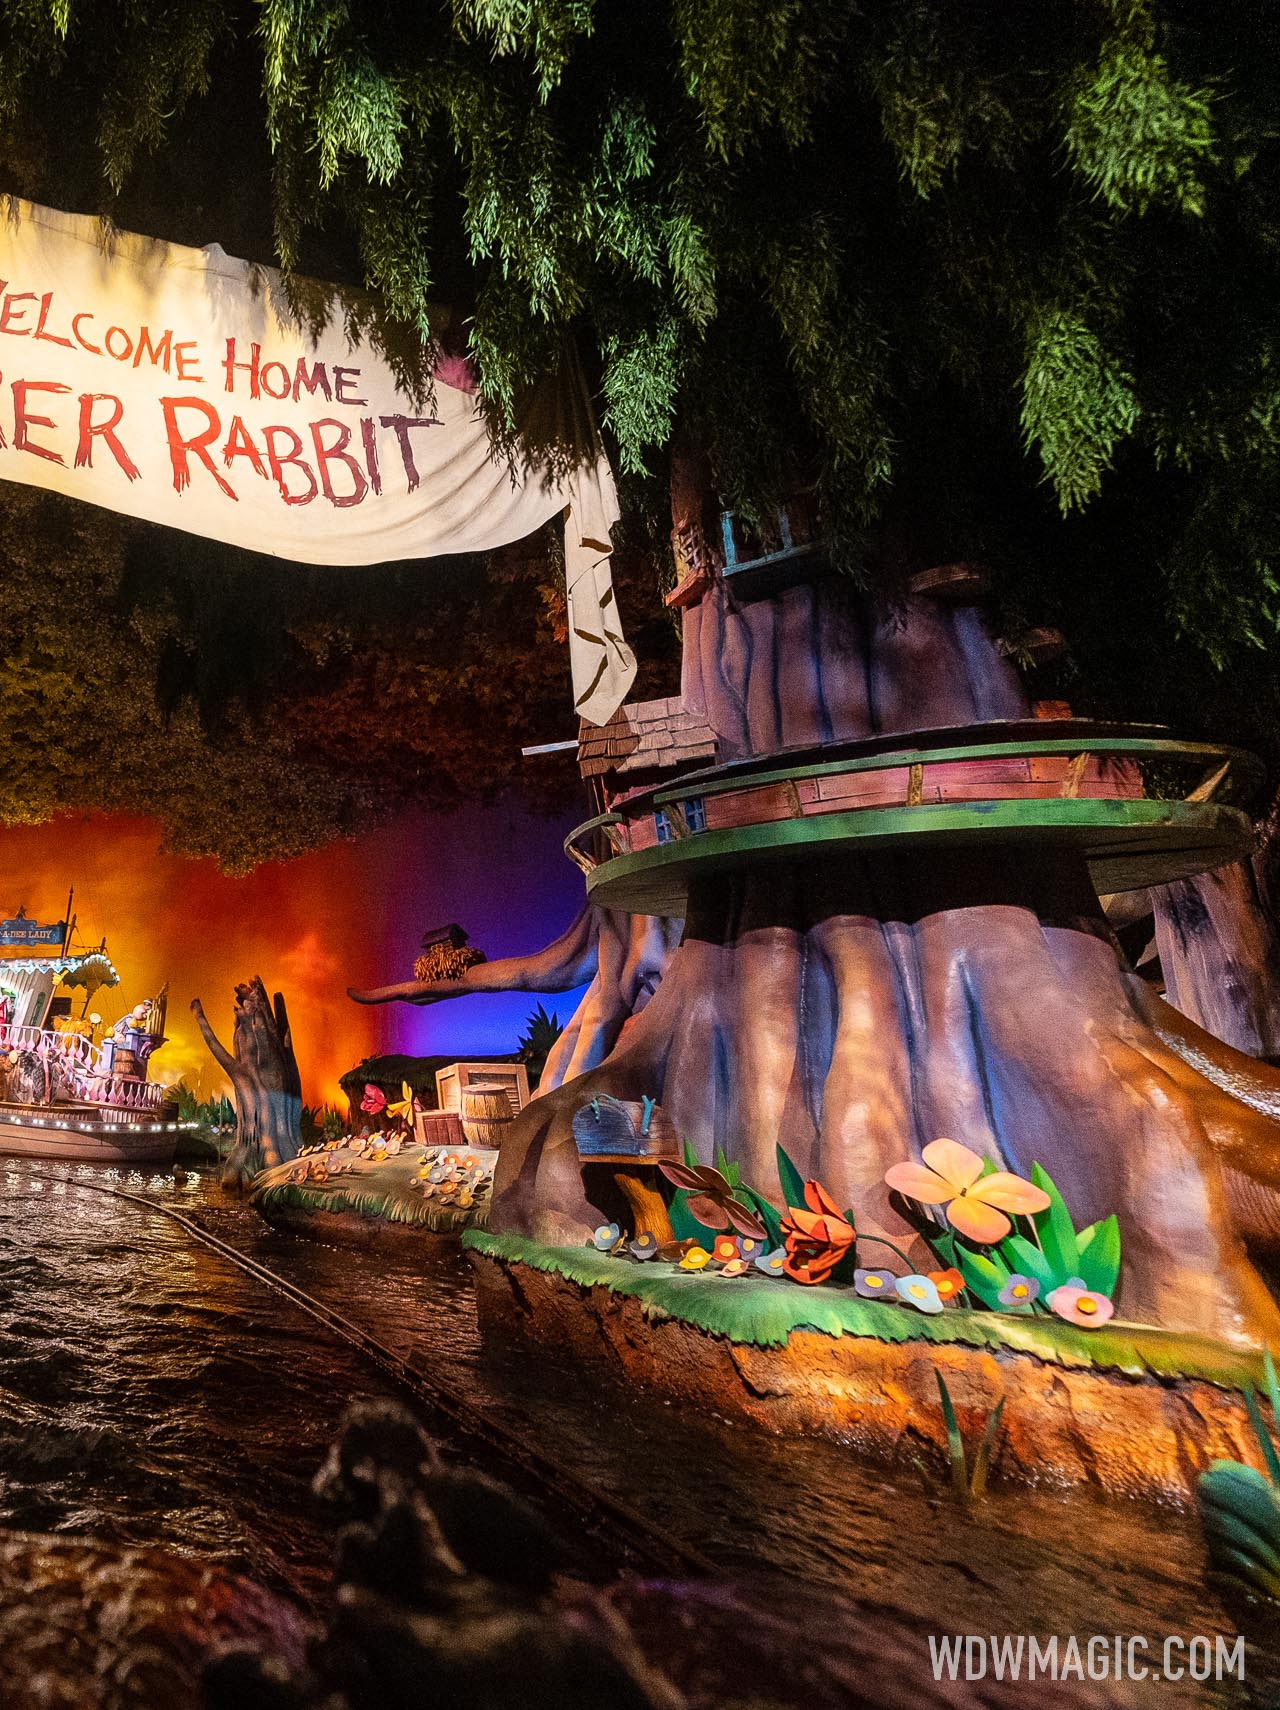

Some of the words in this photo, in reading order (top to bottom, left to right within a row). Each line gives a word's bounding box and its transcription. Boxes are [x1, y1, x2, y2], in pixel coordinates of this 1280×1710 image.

[222, 336, 369, 406] HOME
[159, 396, 446, 508] RABBIT
[28, 930, 52, 939] LADY
